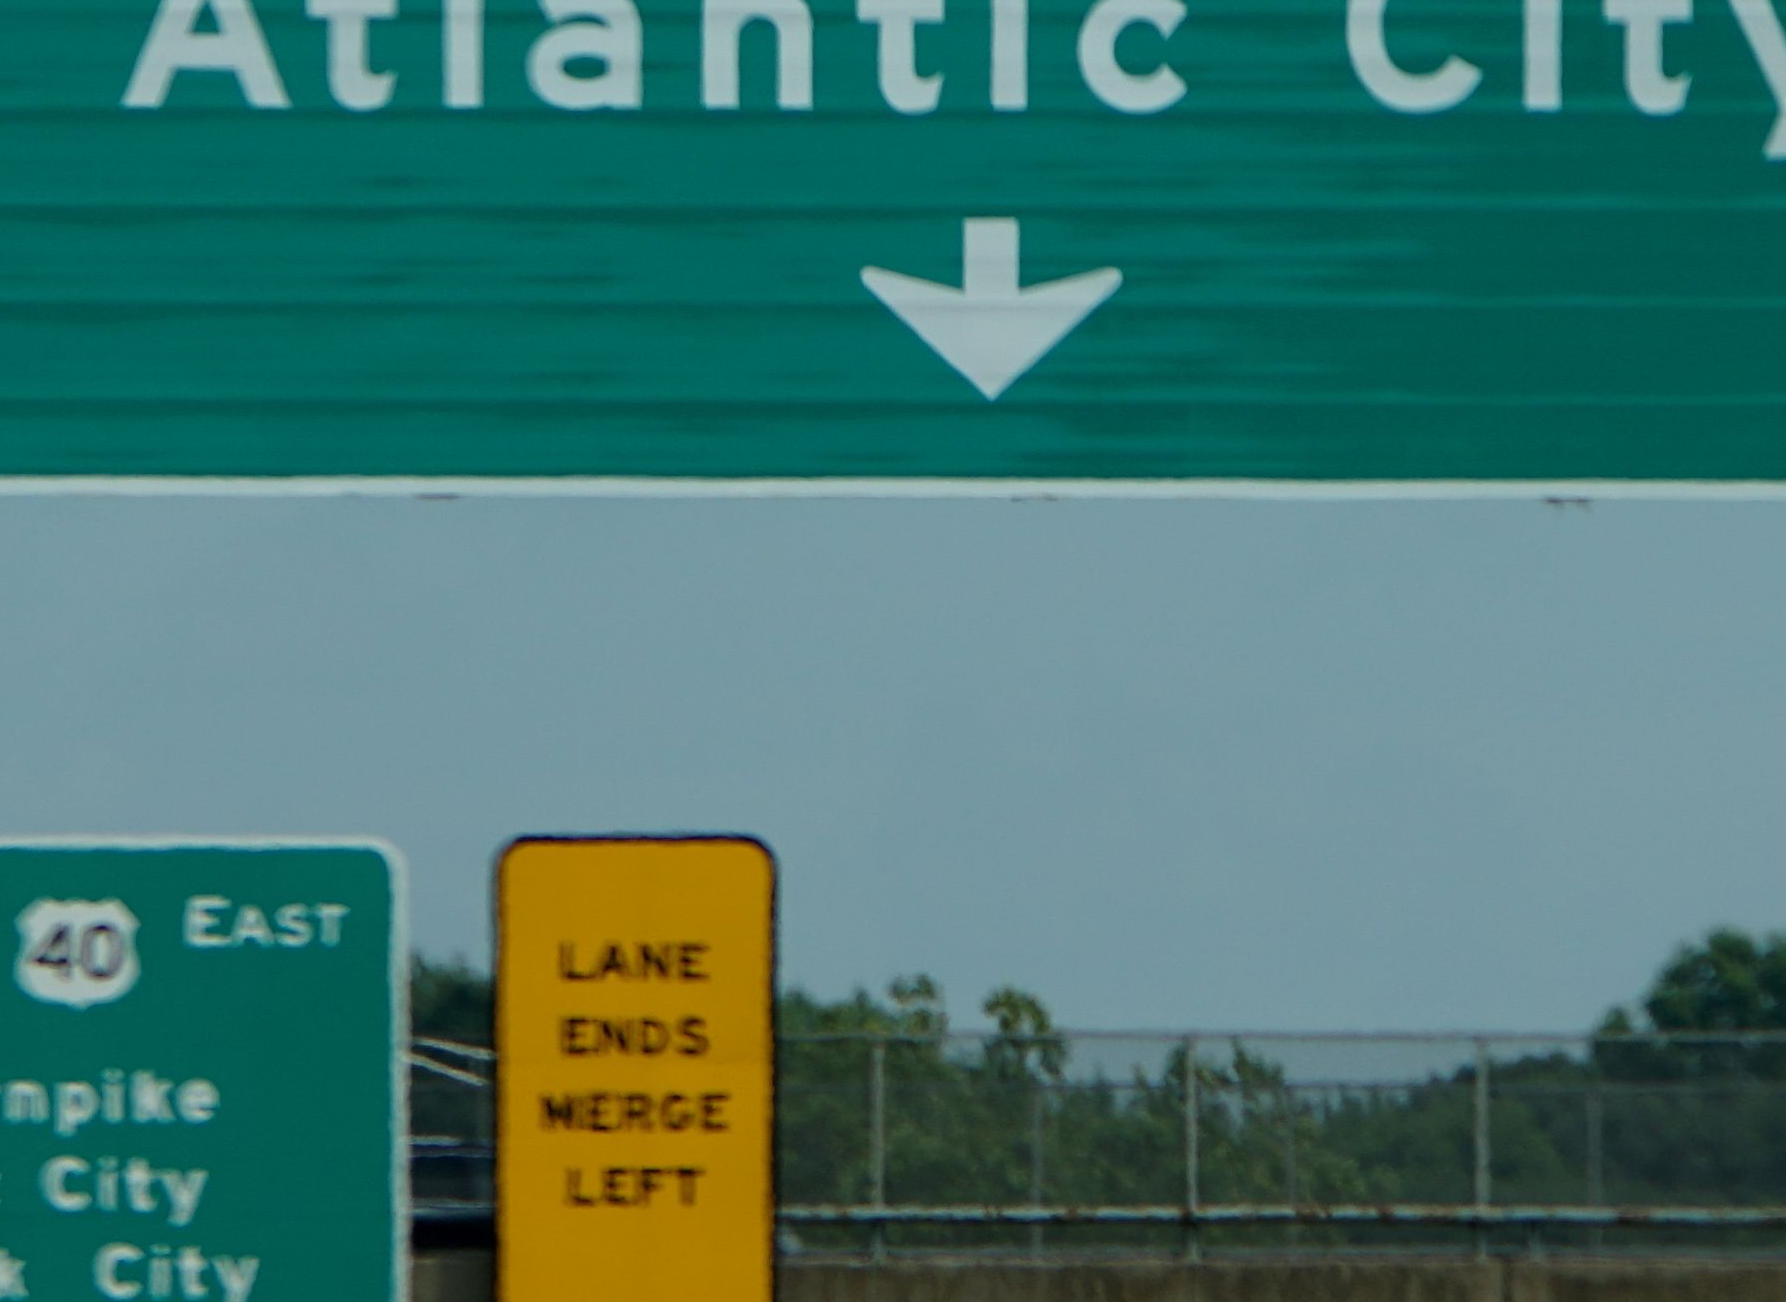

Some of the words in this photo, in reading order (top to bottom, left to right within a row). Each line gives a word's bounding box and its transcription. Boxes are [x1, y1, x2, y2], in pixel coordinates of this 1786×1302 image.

[184, 894, 348, 948] EAST
[28, 923, 125, 979] 40
[560, 942, 708, 981] LANE
[560, 1015, 710, 1057] ENDS
[540, 1091, 729, 1133] MERGE
[43, 1154, 208, 1226] City
[567, 1165, 704, 1207] LEFT
